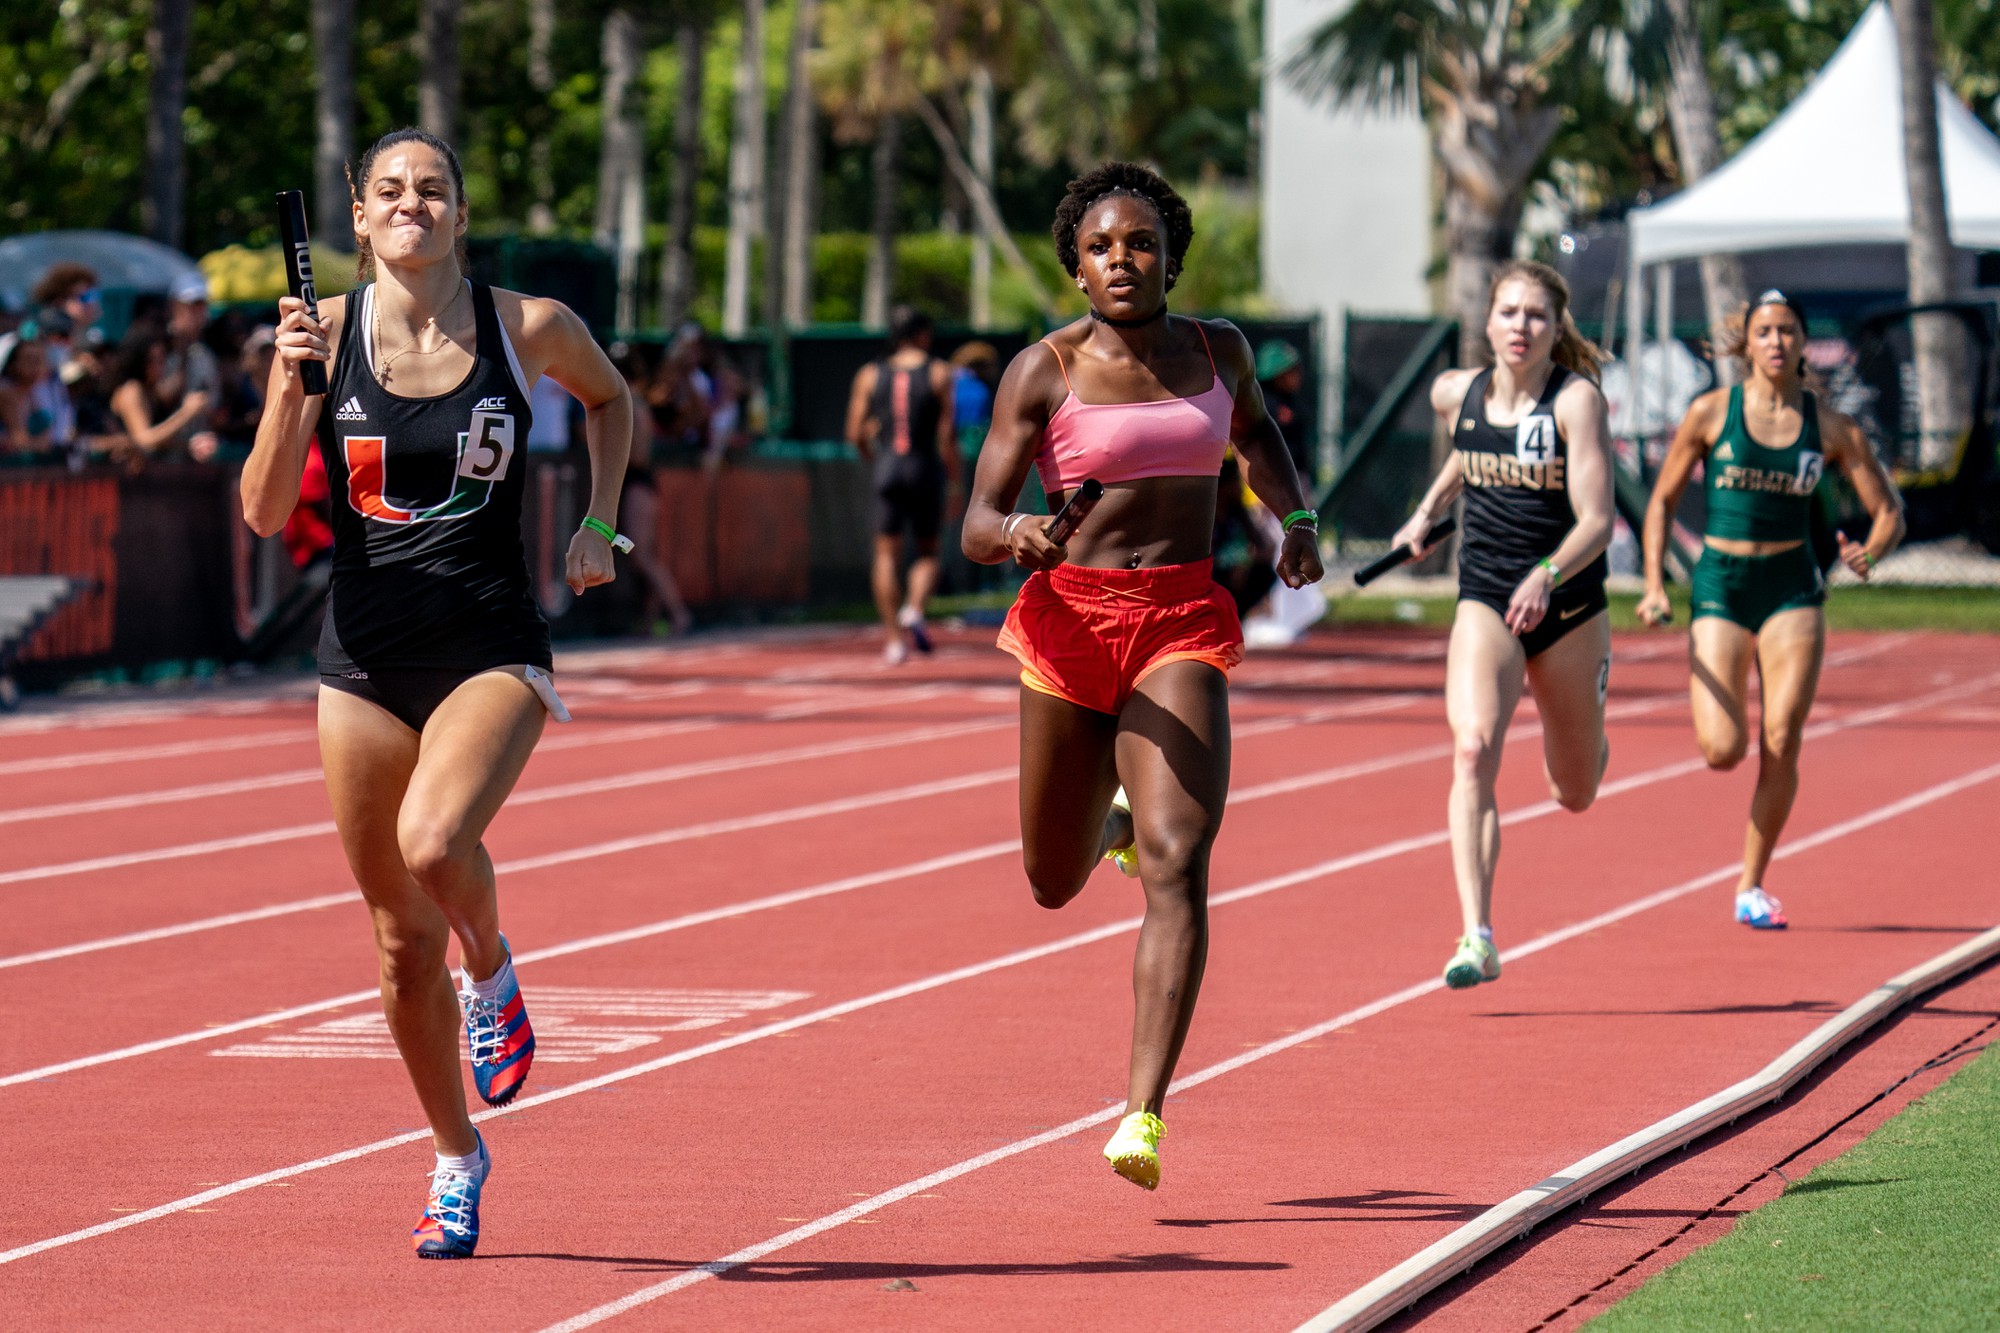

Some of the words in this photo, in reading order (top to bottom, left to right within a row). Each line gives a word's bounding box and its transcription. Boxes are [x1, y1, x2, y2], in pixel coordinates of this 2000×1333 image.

[335, 411, 367, 421] adidas
[475, 396, 507, 408] ACC
[471, 417, 505, 477] 5
[1525, 420, 1548, 460] 4
[1459, 451, 1565, 491] URDUE
[1802, 458, 1817, 490] 6
